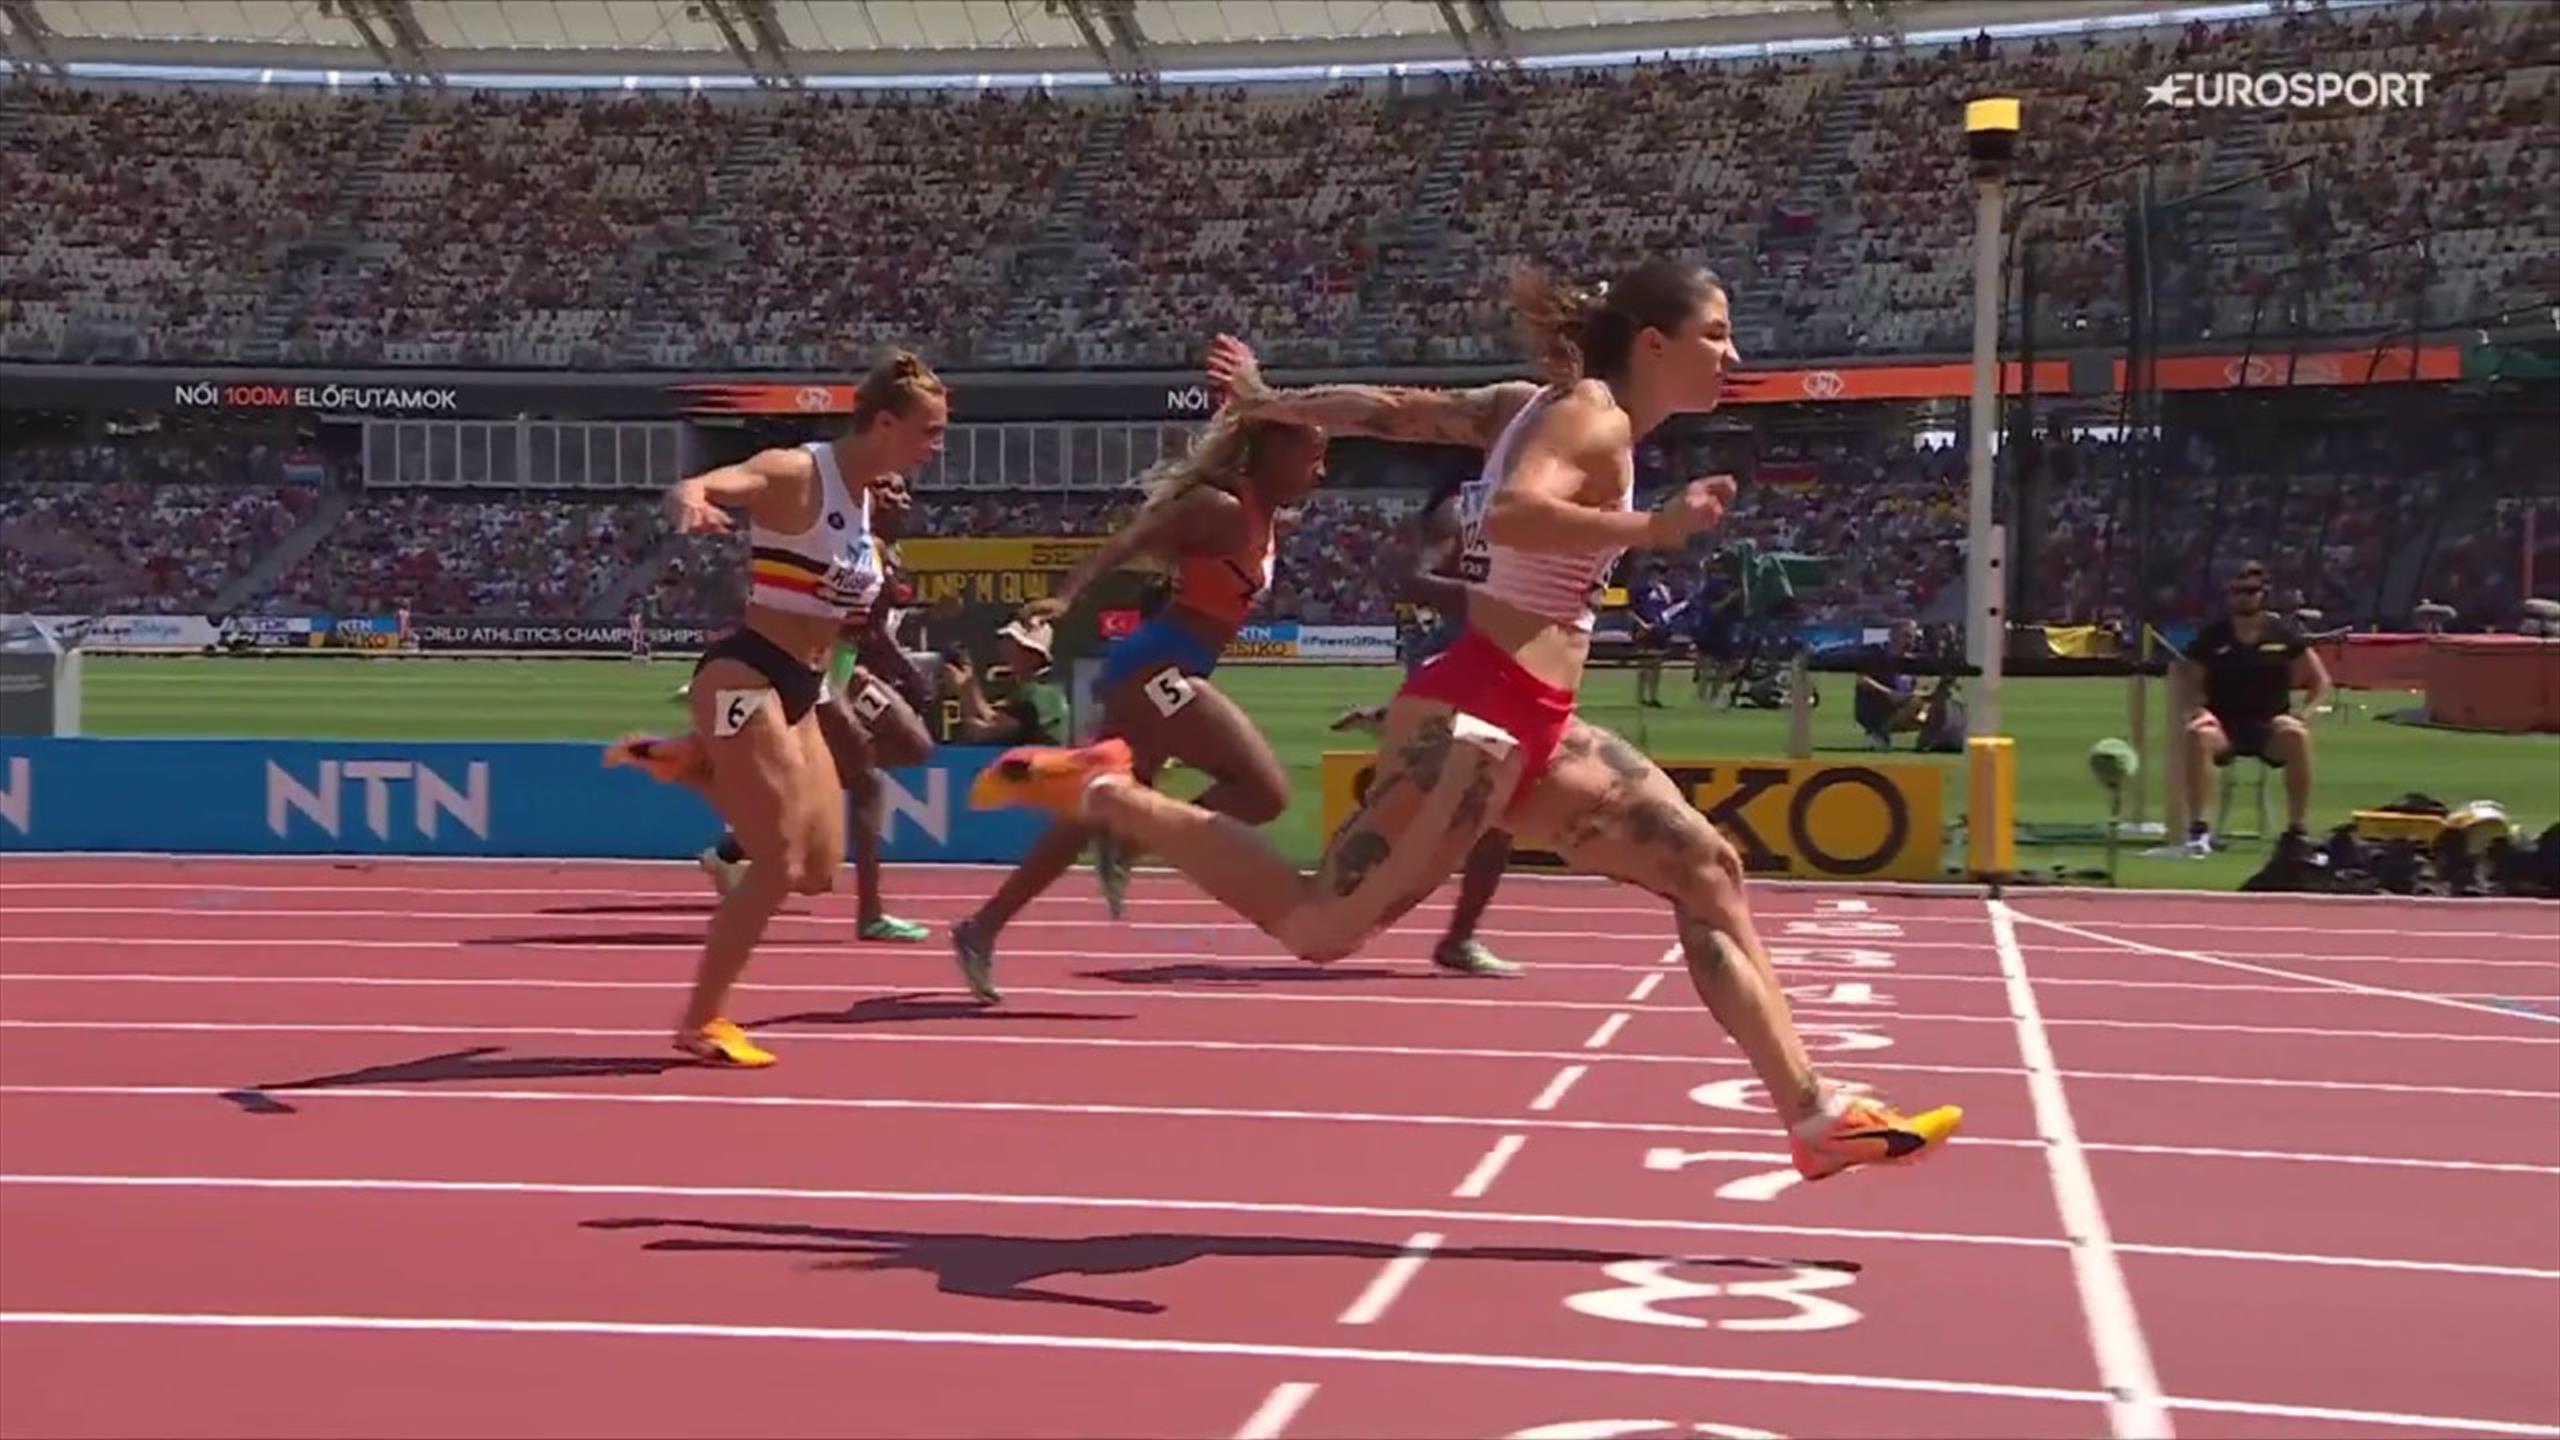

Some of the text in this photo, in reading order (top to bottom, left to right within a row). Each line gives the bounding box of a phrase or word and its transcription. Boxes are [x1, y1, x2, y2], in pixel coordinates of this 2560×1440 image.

[223, 387, 289, 406] 100M
[295, 384, 457, 410] ELŐFUTAMOK
[424, 627, 468, 642] ORLD
[472, 627, 561, 643] ATHLETICS
[1159, 679, 1181, 705] 5
[728, 697, 745, 729] 6
[266, 760, 489, 841] NTN
[1781, 982, 1899, 1005] 4
[1644, 1146, 1867, 1202] 7
[1562, 1254, 1865, 1332] 8
